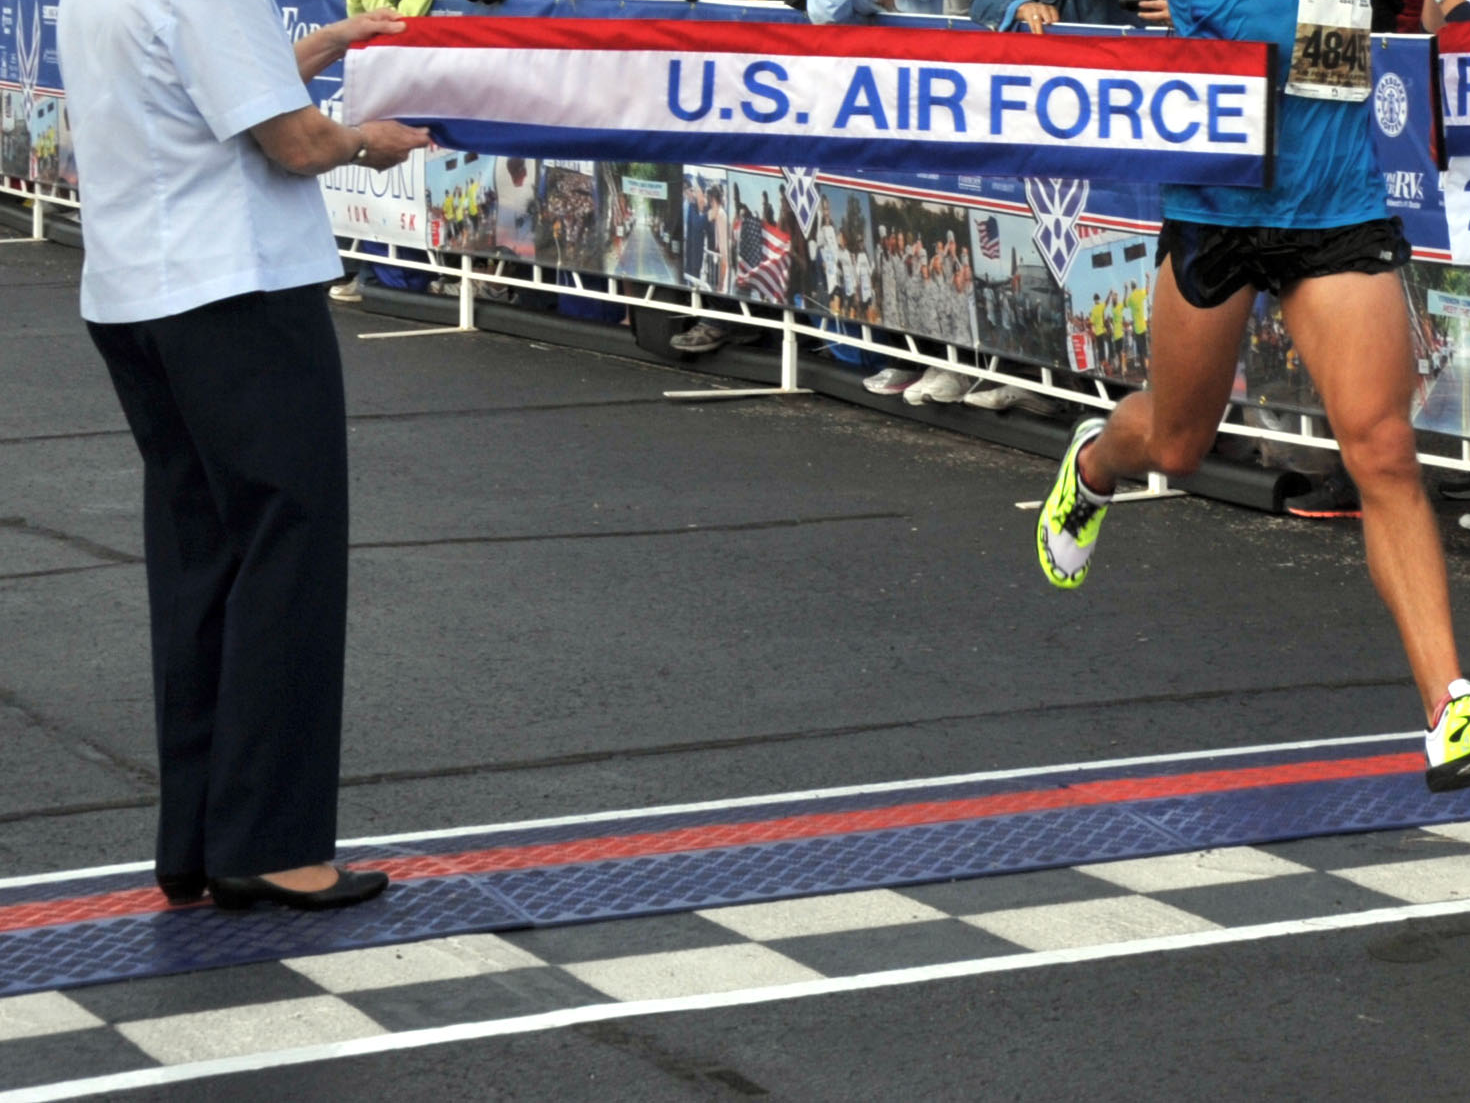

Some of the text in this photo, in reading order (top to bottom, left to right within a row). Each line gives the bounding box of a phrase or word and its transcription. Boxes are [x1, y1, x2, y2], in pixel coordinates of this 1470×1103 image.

[668, 59, 1248, 145] U.S. AIR FORCE
[401, 212, 416, 231] 5K
